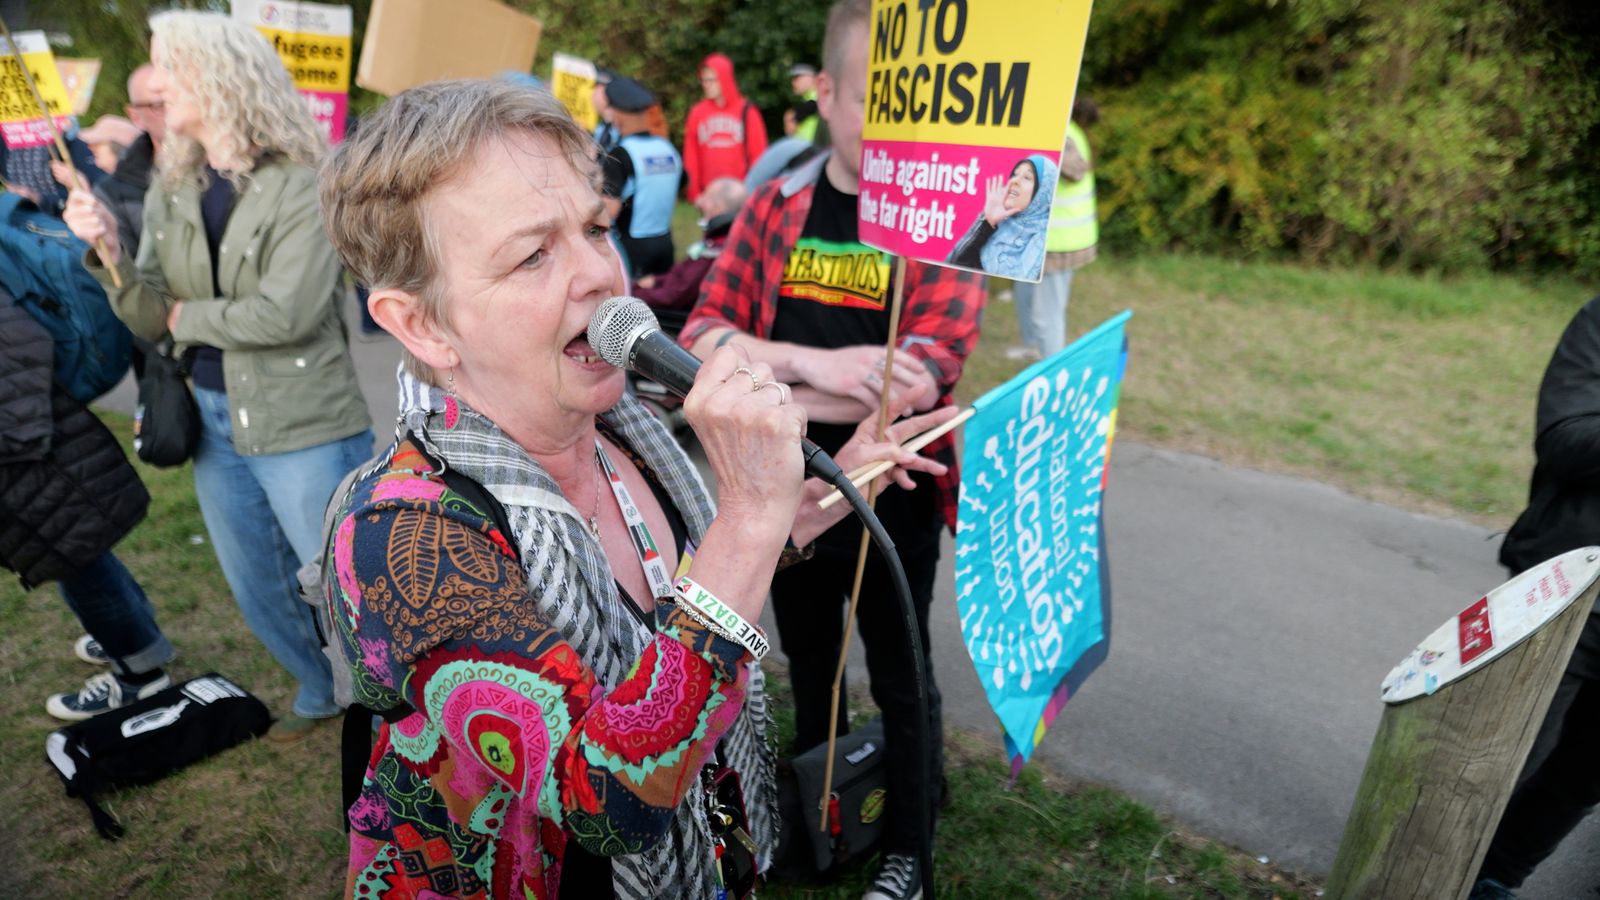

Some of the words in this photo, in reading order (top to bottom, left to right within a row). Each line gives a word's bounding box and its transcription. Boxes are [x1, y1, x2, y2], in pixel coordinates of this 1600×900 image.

[274, 33, 344, 63] fugees
[873, 3, 907, 63] NO
[917, 0, 968, 55] TO
[868, 61, 1030, 127] FASCISM
[862, 148, 894, 185] Unite
[895, 151, 980, 196] against
[860, 189, 878, 224] the
[879, 192, 899, 229] far
[898, 197, 956, 244] right
[1013, 375, 1063, 673] education
[1050, 429, 1076, 574] national
[990, 499, 1018, 614] union
[695, 590, 739, 629] GAZA
[736, 622, 768, 658] SAVE
